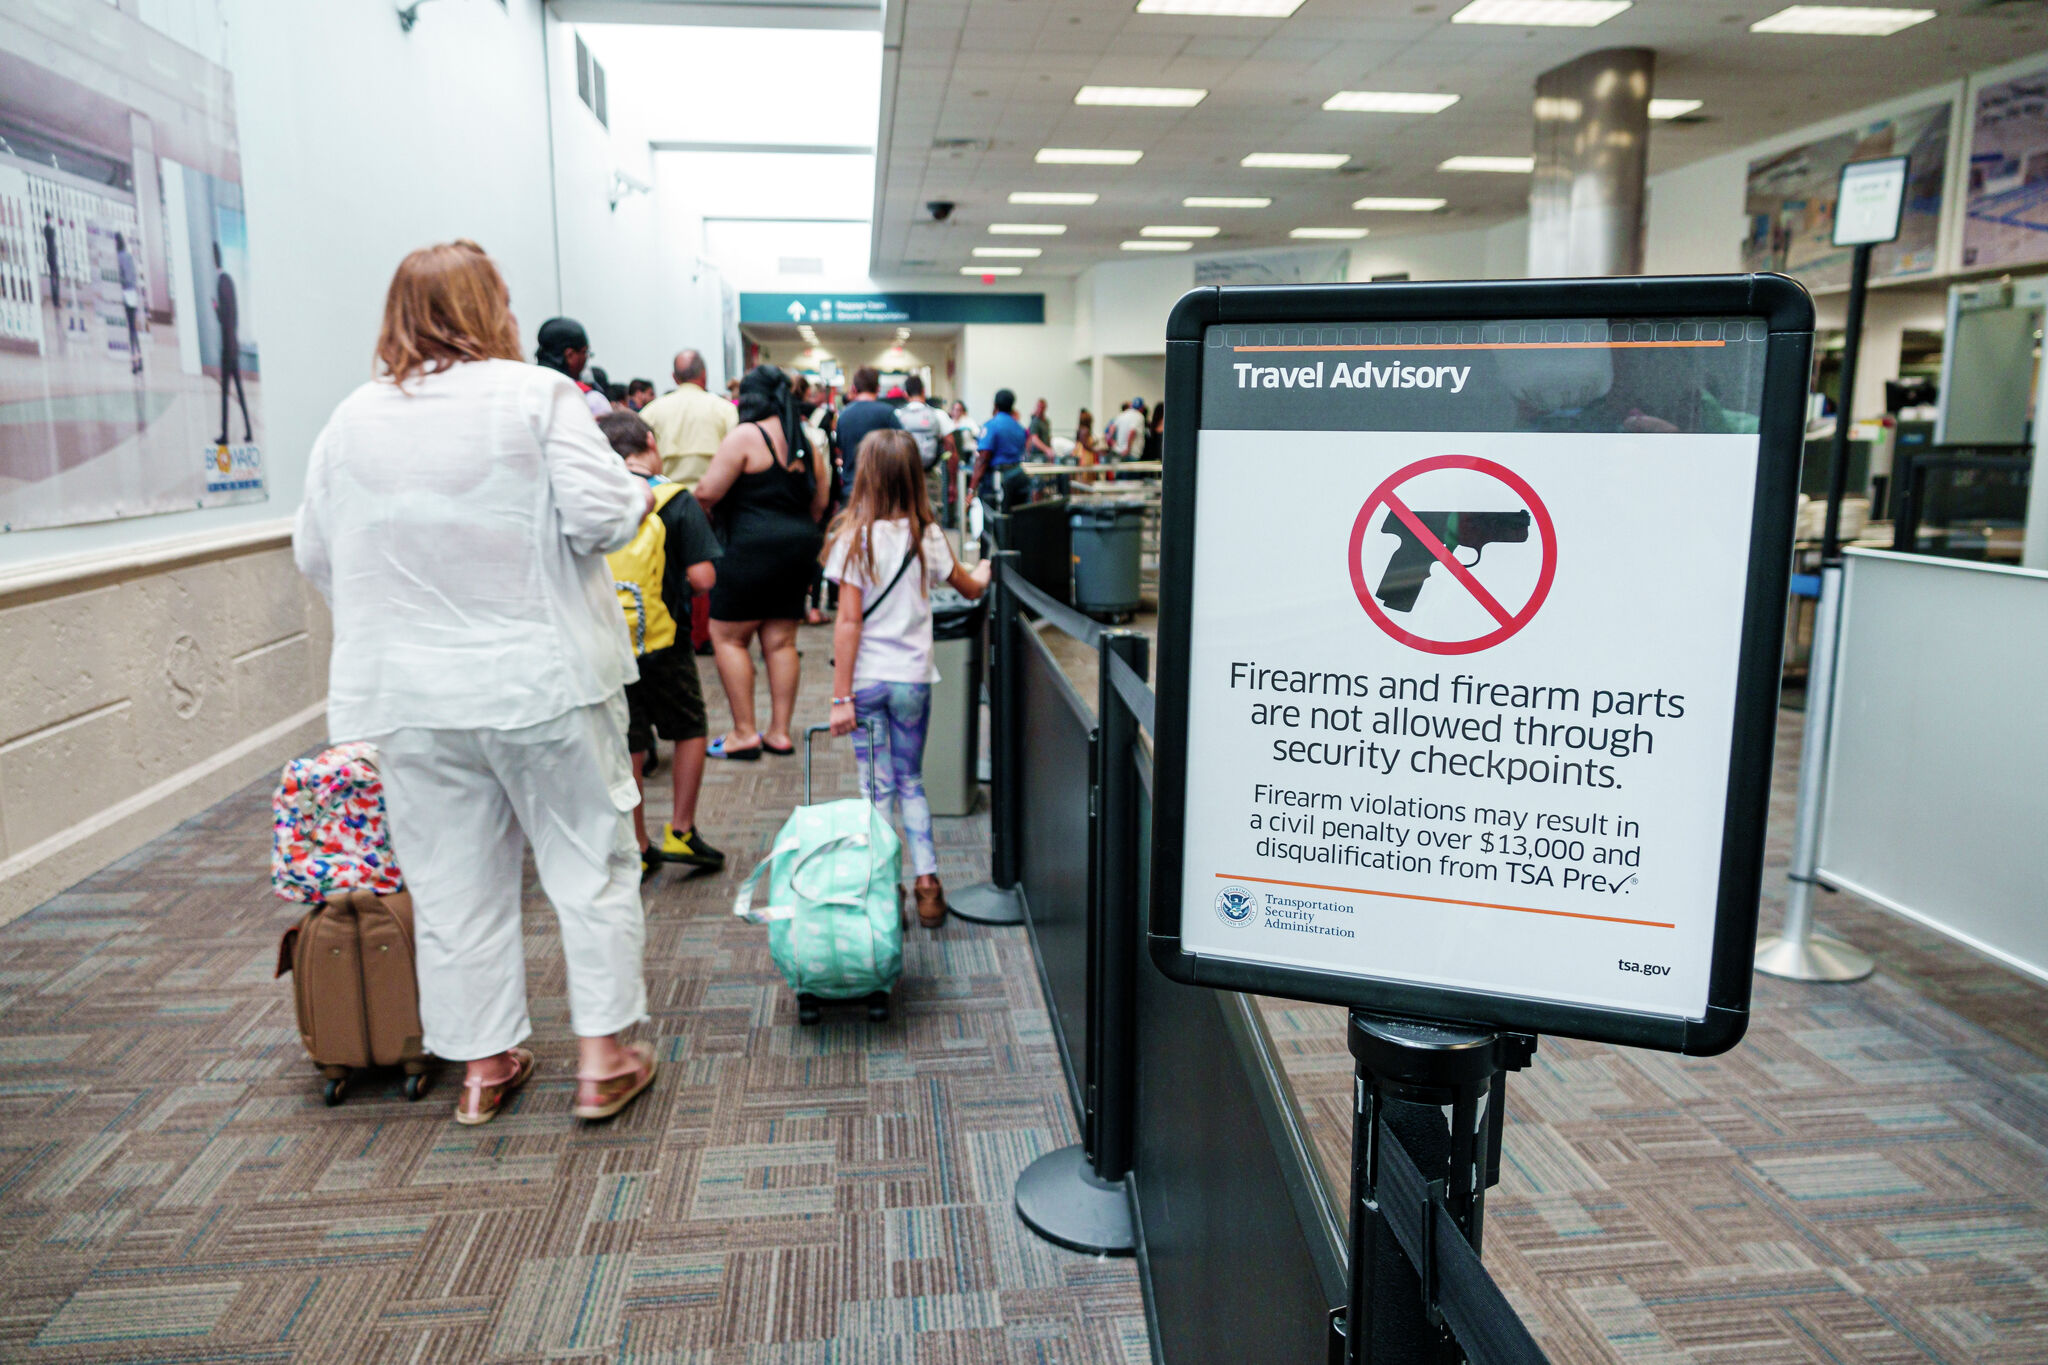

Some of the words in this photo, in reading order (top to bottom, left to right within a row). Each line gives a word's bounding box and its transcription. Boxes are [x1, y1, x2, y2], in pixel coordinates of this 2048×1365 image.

[1233, 361, 1324, 389] Travel
[1329, 360, 1472, 394] Advisory
[1230, 661, 1369, 698] Firearms
[1378, 673, 1440, 702] and
[1450, 674, 1580, 712] firearm
[1592, 688, 1685, 719] parts
[1251, 703, 1301, 728] are
[1311, 705, 1363, 733] not
[1372, 706, 1502, 743] allowed
[1513, 715, 1653, 758] through
[1272, 739, 1401, 775] security
[1410, 744, 1622, 790] checkpoints.
[1254, 783, 1342, 811] Firearm
[1349, 792, 1466, 823] violations
[1474, 807, 1529, 832] may
[1536, 813, 1609, 836] result
[1616, 815, 1639, 839] in
[1250, 813, 1262, 830] a
[1269, 811, 1314, 835] civil
[1322, 820, 1411, 848] penalty
[1417, 830, 1473, 850] over
[1480, 830, 1585, 862] $13,000
[1592, 845, 1641, 868] and
[1256, 836, 1432, 874] disqualification
[1439, 855, 1498, 881] from
[1505, 861, 1555, 887] TSA
[1264, 893, 1355, 914] Transportation
[1264, 906, 1315, 924] Security
[1264, 918, 1355, 938] Administration
[1618, 959, 1671, 976] tsa.gov
